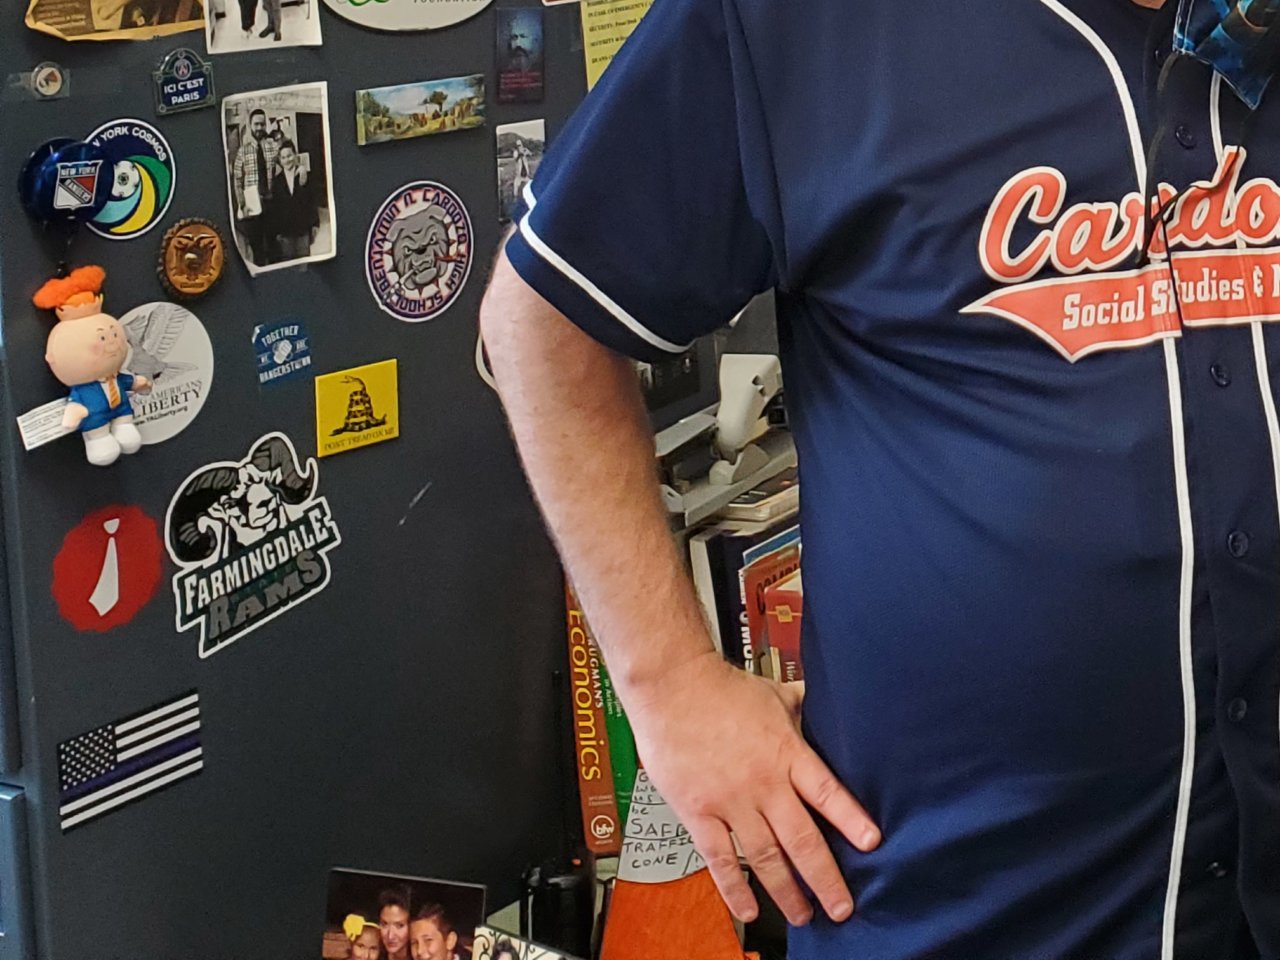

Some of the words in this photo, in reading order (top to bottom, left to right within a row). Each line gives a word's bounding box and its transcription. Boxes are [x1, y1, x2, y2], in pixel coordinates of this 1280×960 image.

[164, 83, 176, 94] ICI
[171, 91, 200, 105] PARIS
[100, 125, 129, 142] YORK
[131, 126, 167, 162] COSMOS
[422, 188, 467, 245] CARDOZO
[445, 251, 467, 291] HIGH
[1062, 284, 1145, 331] Social
[1150, 264, 1245, 316] Studies
[1252, 265, 1264, 298] &
[132, 388, 200, 420] LIBERTY
[184, 508, 329, 616] FARMINGDALE
[209, 549, 322, 639] RAMS
[632, 853, 678, 868] CONE
